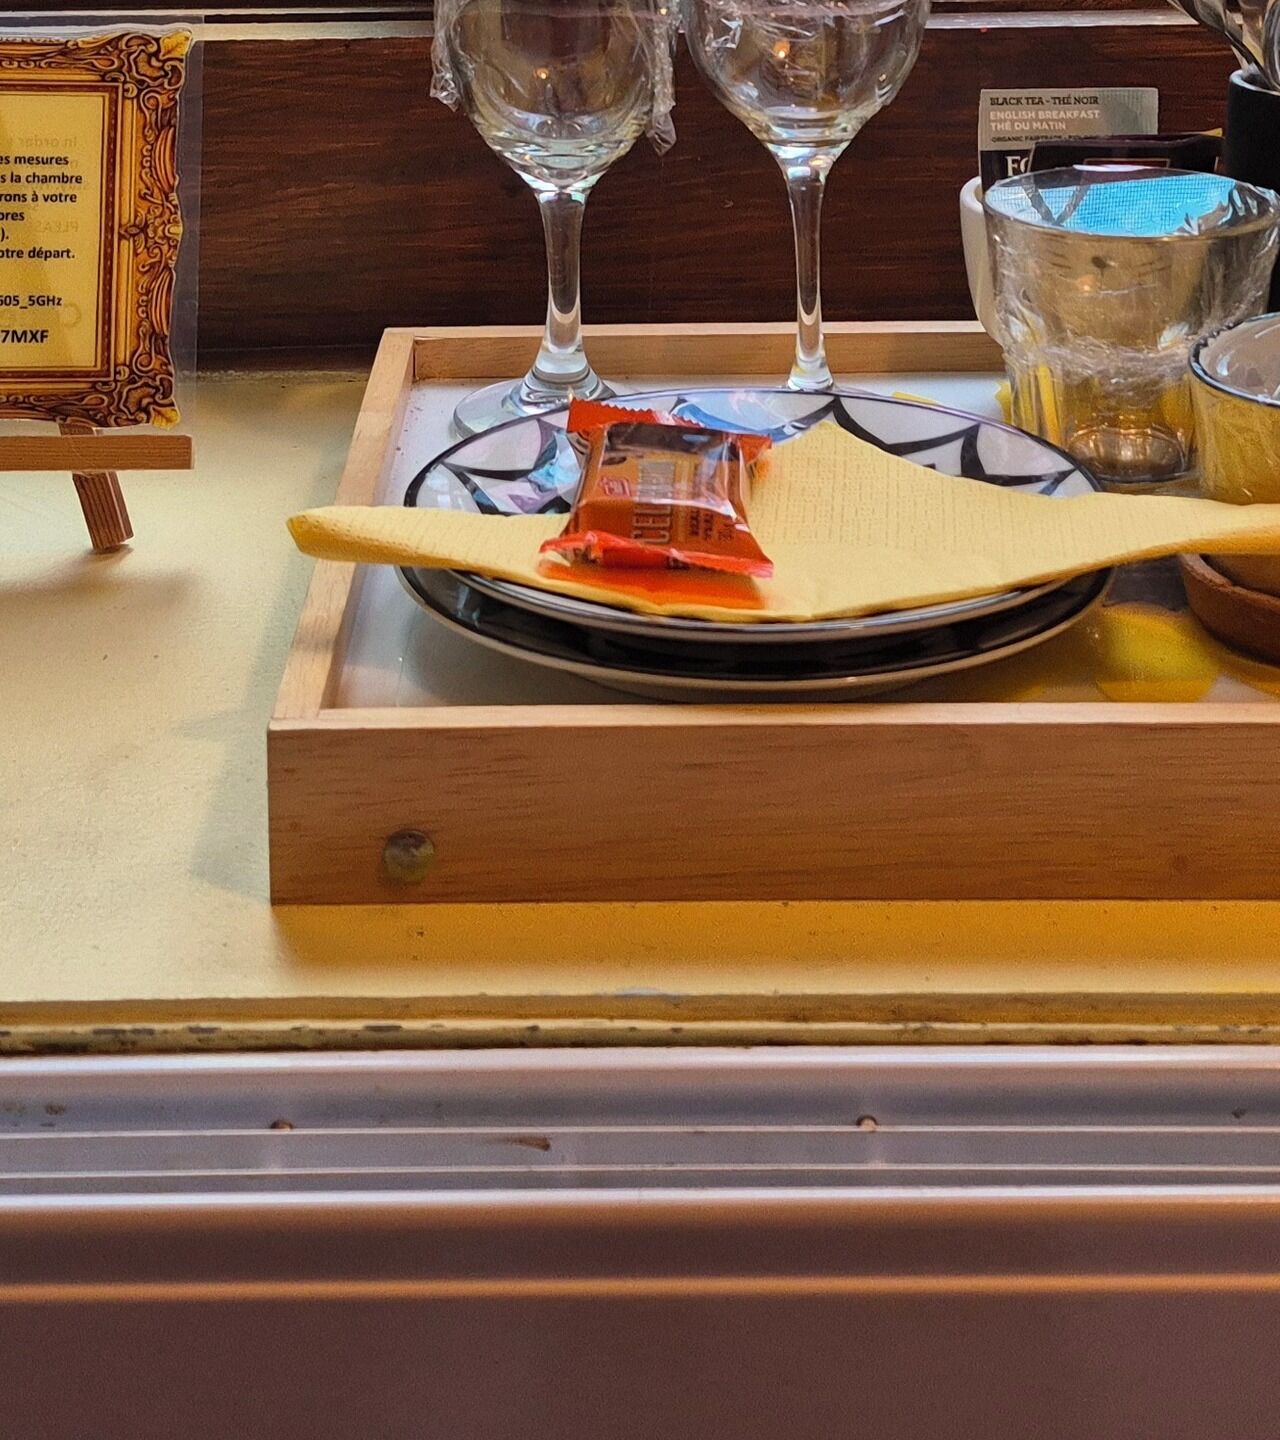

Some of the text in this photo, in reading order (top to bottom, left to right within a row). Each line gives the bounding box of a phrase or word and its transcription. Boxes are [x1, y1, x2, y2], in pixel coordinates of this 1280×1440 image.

[989, 97, 1023, 106] BLACK
[1024, 97, 1044, 106] TEA
[1074, 96, 1100, 106] NOIR
[989, 110, 1101, 120] ENGLISH BREAKFAST
[990, 120, 1066, 131] THÉ DU MATIN
[13, 155, 70, 166] mesures
[9, 171, 22, 184] la
[25, 171, 83, 185] chambre
[31, 190, 39, 203] à
[42, 192, 78, 204] votre
[27, 246, 76, 262] départ.
